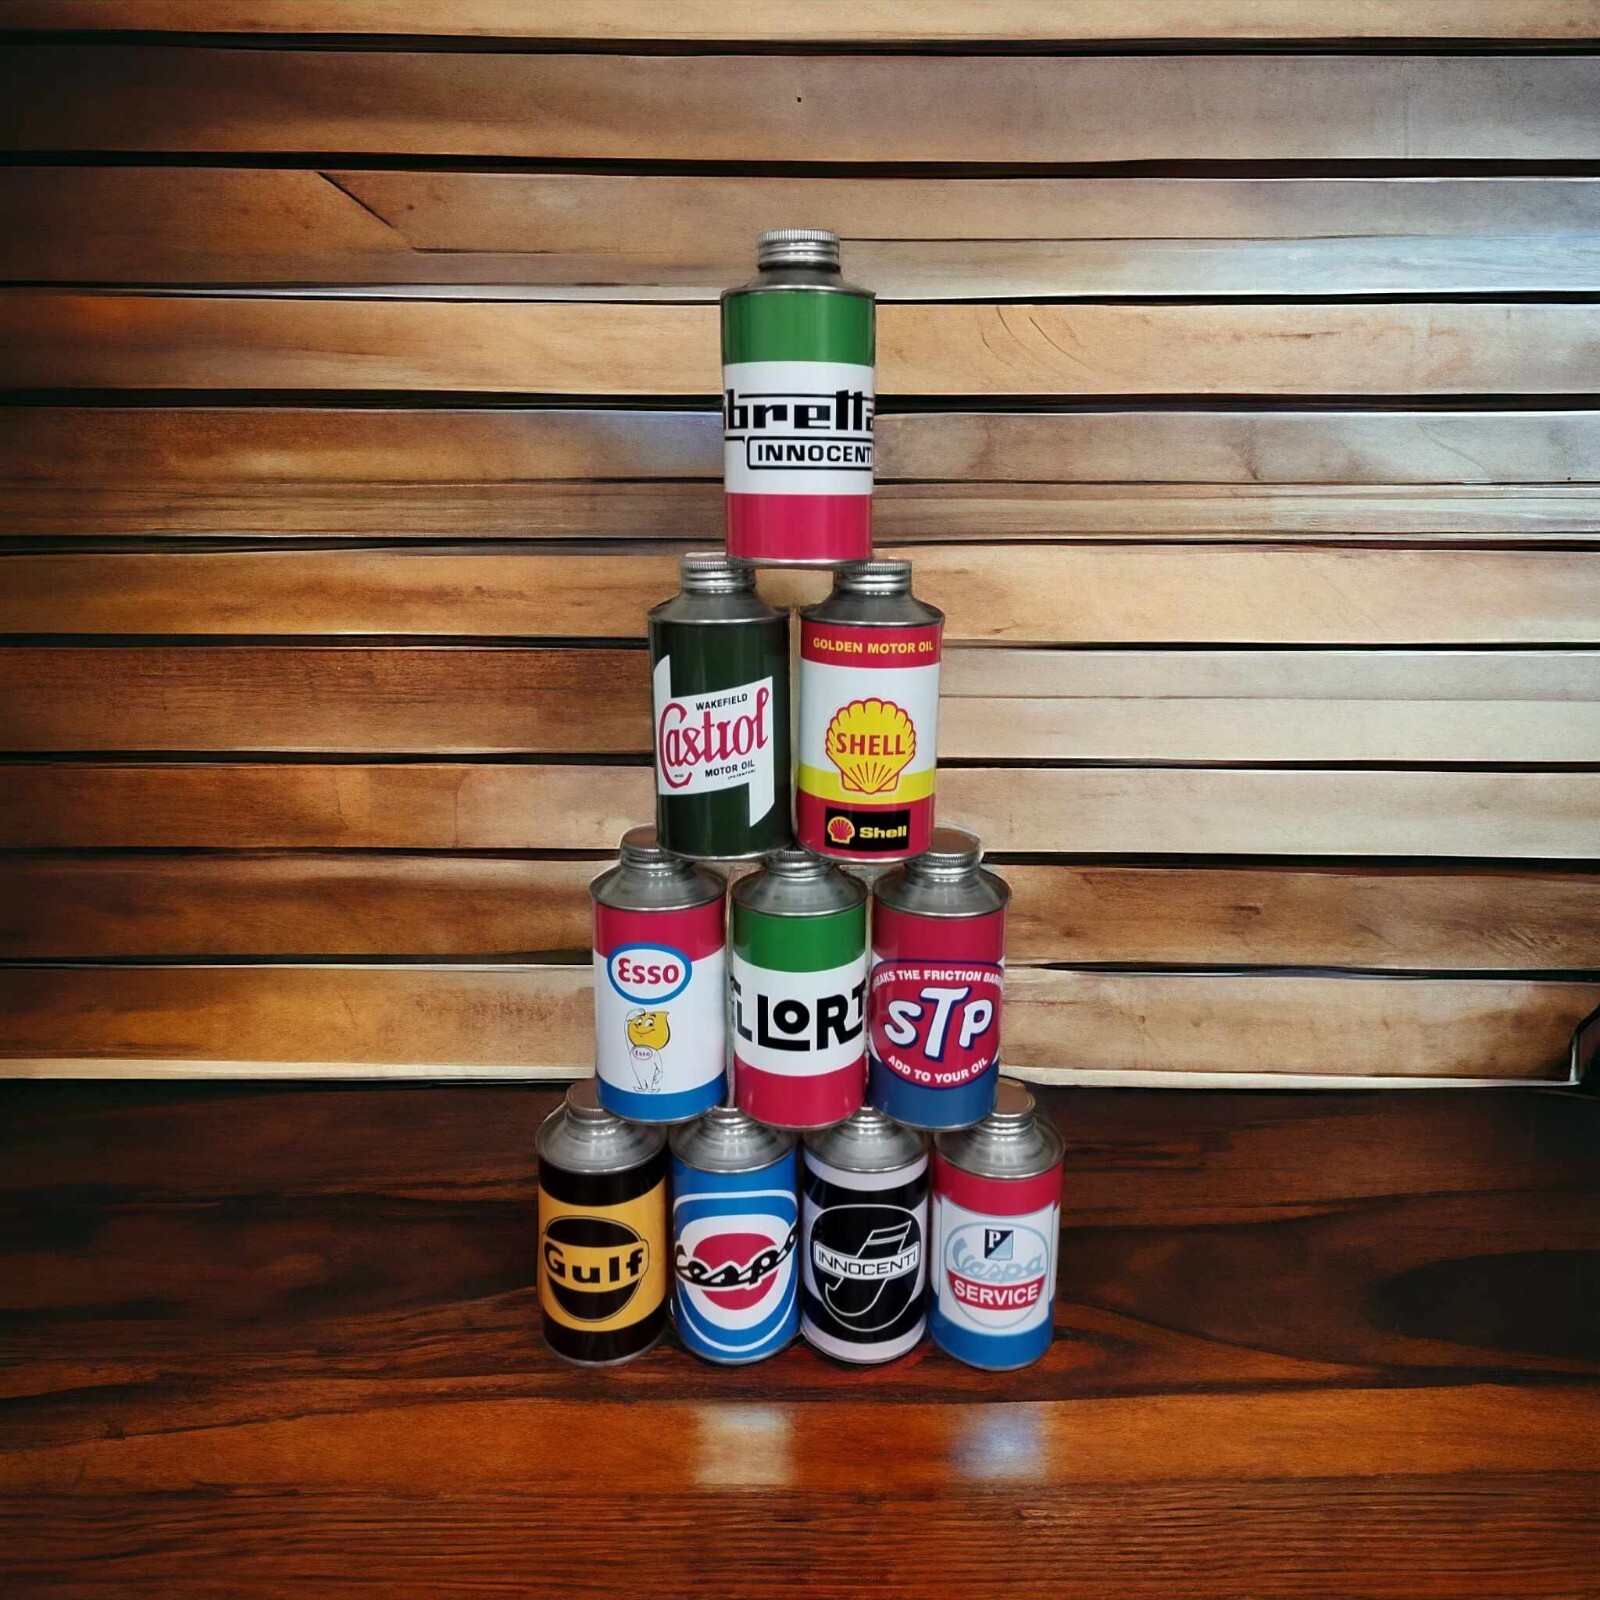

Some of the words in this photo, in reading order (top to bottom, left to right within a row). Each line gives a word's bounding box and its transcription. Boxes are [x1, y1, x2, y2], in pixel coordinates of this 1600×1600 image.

[813, 638, 863, 653] GOLDEN
[867, 643, 915, 654] MOTOR
[918, 641, 933, 652] OIL
[695, 693, 748, 711] WAKEFIELD
[659, 687, 769, 788] Castrol
[836, 733, 905, 756] SHELL
[704, 765, 738, 778] MOTOR
[741, 760, 755, 770] OIL
[859, 825, 907, 839] Shell
[618, 957, 679, 985] Esso
[896, 970, 921, 980] THE
[923, 970, 981, 981] FRICTION
[884, 986, 994, 1060] STP
[888, 1055, 911, 1075] ADD
[914, 1069, 931, 1082] TO
[934, 1069, 969, 1083] YOUR
[971, 1058, 988, 1073] OIL
[988, 1230, 1001, 1248] P
[544, 1241, 643, 1283] Gulf
[818, 1249, 916, 1275] INNOCENTI
[952, 1237, 1044, 1283] Vespa
[954, 1280, 1039, 1306] SERVICE
